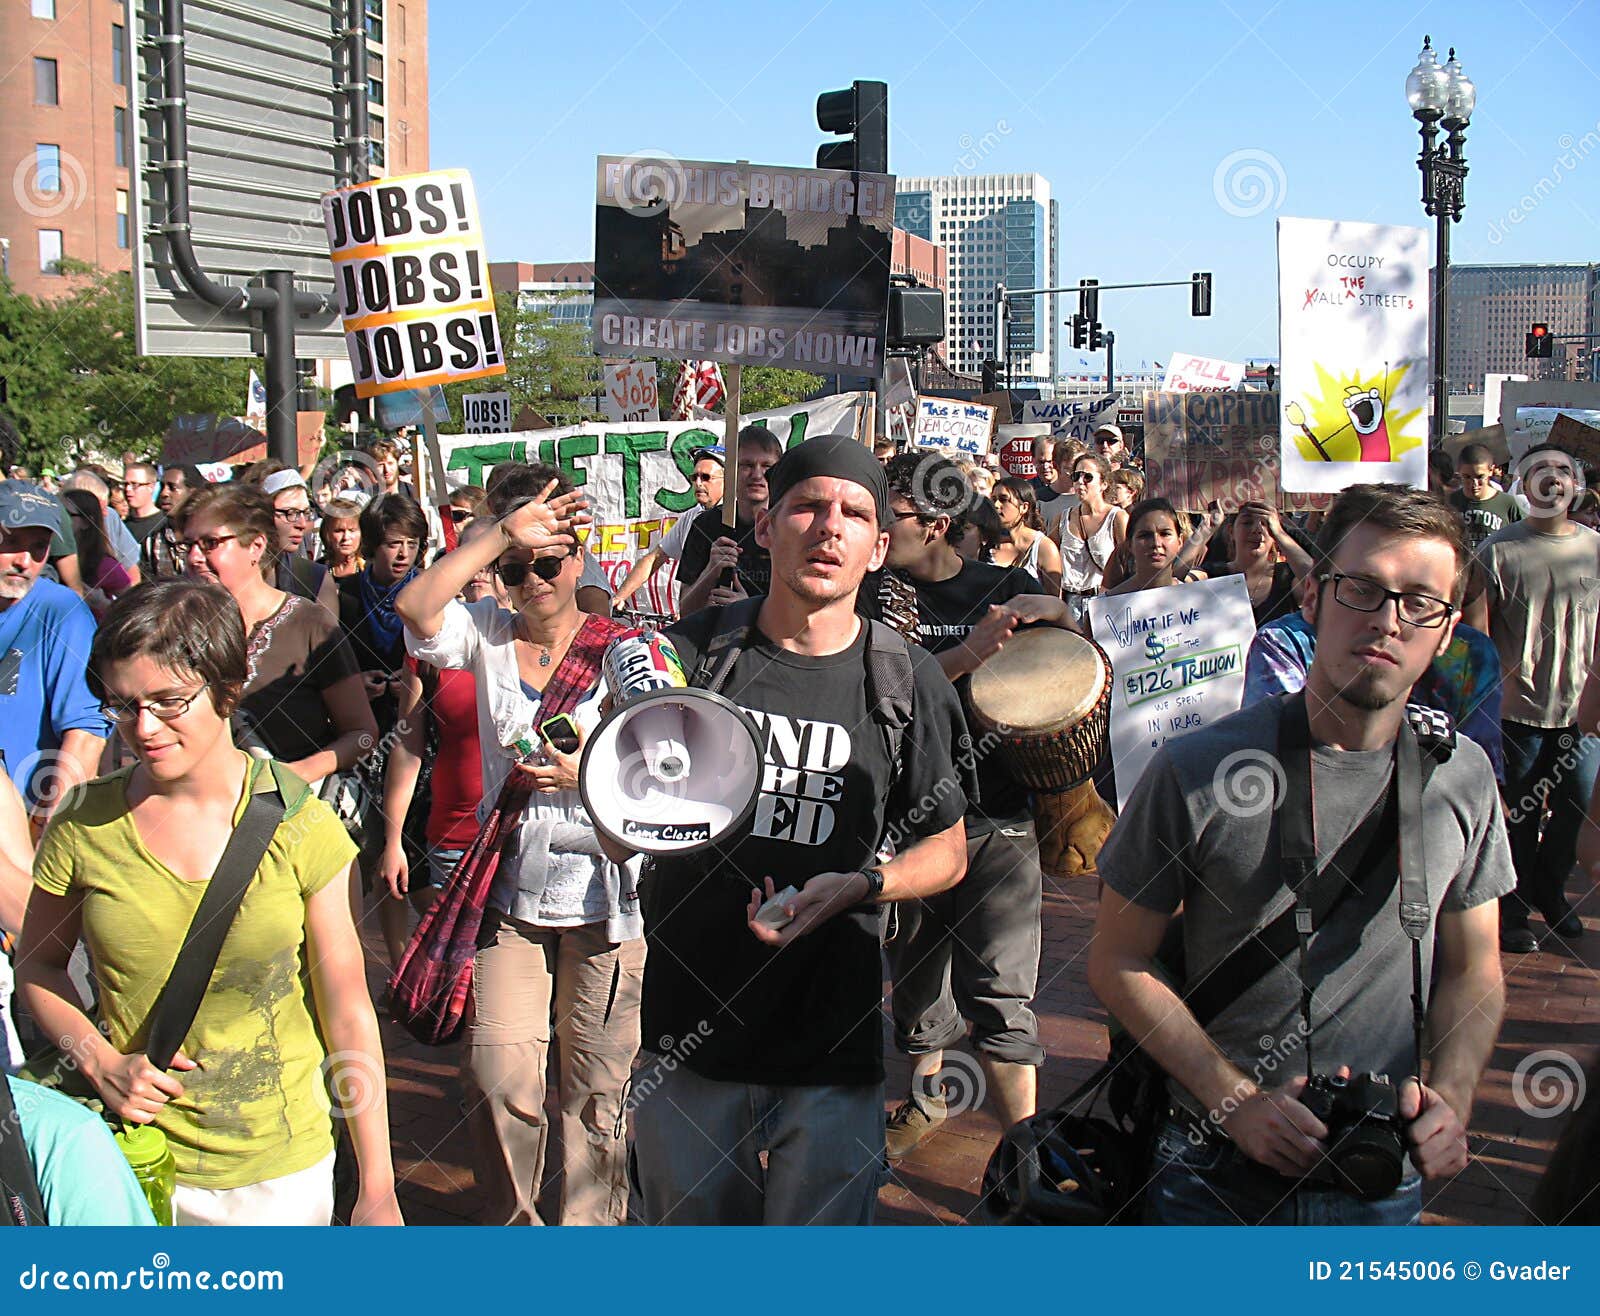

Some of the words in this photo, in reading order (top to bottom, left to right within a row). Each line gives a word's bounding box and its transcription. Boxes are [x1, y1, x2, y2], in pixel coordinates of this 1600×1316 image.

[748, 172, 886, 218] BRIDGE!
[331, 183, 470, 248] JOBS!
[1327, 254, 1385, 269] OCCUPY
[342, 250, 483, 316] JOBS!
[1340, 276, 1365, 289] THE
[354, 315, 499, 380] JOBS!
[602, 314, 705, 352] CREATE
[713, 323, 785, 359] JOBS
[794, 331, 877, 369] NOW!
[1182, 358, 1231, 381] ALL
[465, 399, 508, 423] JOBS!
[922, 402, 948, 416] This
[1032, 402, 1083, 417] WAKE
[1089, 400, 1115, 413] UP
[918, 417, 987, 437] DEMOCRACY
[1012, 440, 1033, 452] STO
[1459, 510, 1502, 530] STON
[1105, 607, 1157, 648] WHAT
[1162, 613, 1174, 629] IF
[1180, 608, 1200, 625] WE
[1126, 669, 1173, 695] $1.26
[1171, 653, 1236, 687] TRILLION
[1154, 701, 1168, 711] WE
[1176, 692, 1204, 707] SPENT
[1148, 718, 1160, 732] IN
[1170, 713, 1203, 731] IRAQ
[738, 706, 851, 773] ND
[762, 767, 844, 801] HE
[750, 792, 835, 845] ED
[625, 822, 659, 840] Come
[662, 826, 708, 841] Closer
